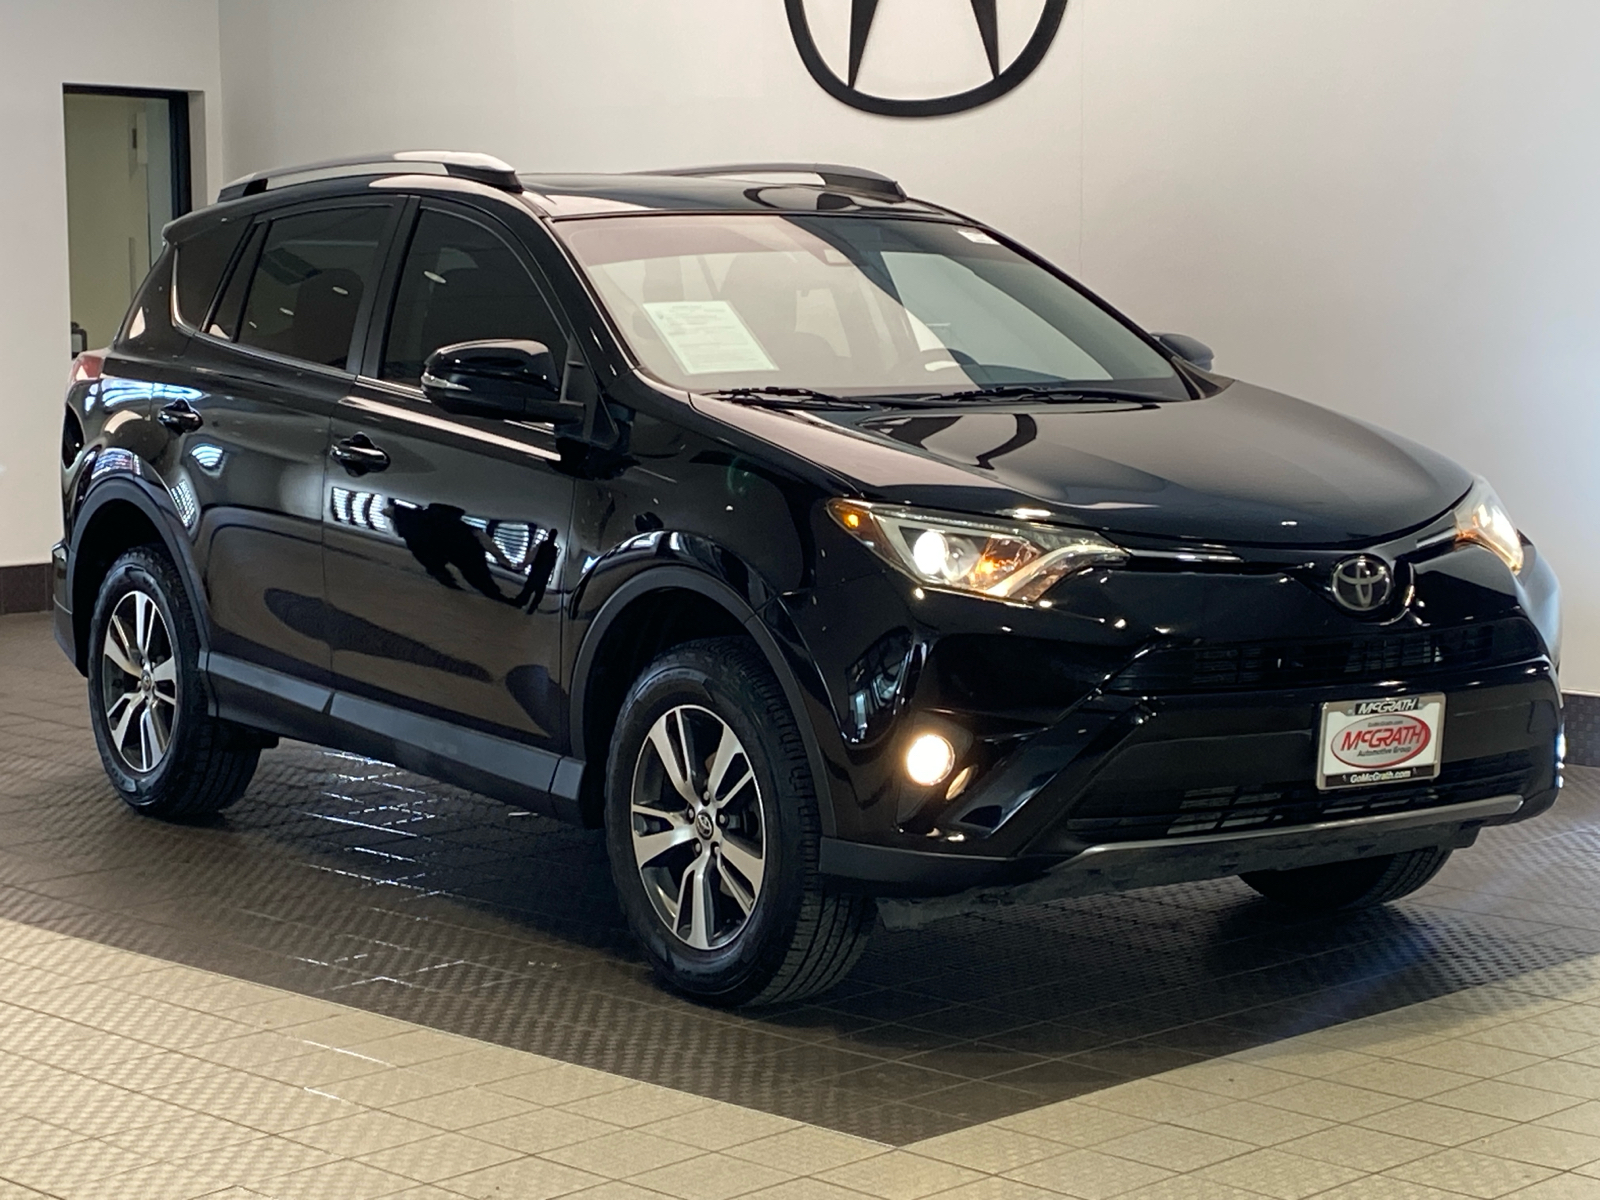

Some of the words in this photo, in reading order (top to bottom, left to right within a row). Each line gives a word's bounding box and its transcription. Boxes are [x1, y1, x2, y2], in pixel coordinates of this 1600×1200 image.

[1357, 748, 1392, 757] Automotive
[1392, 745, 1412, 755] Group
[1350, 770, 1411, 783] GoMcGrath.com
